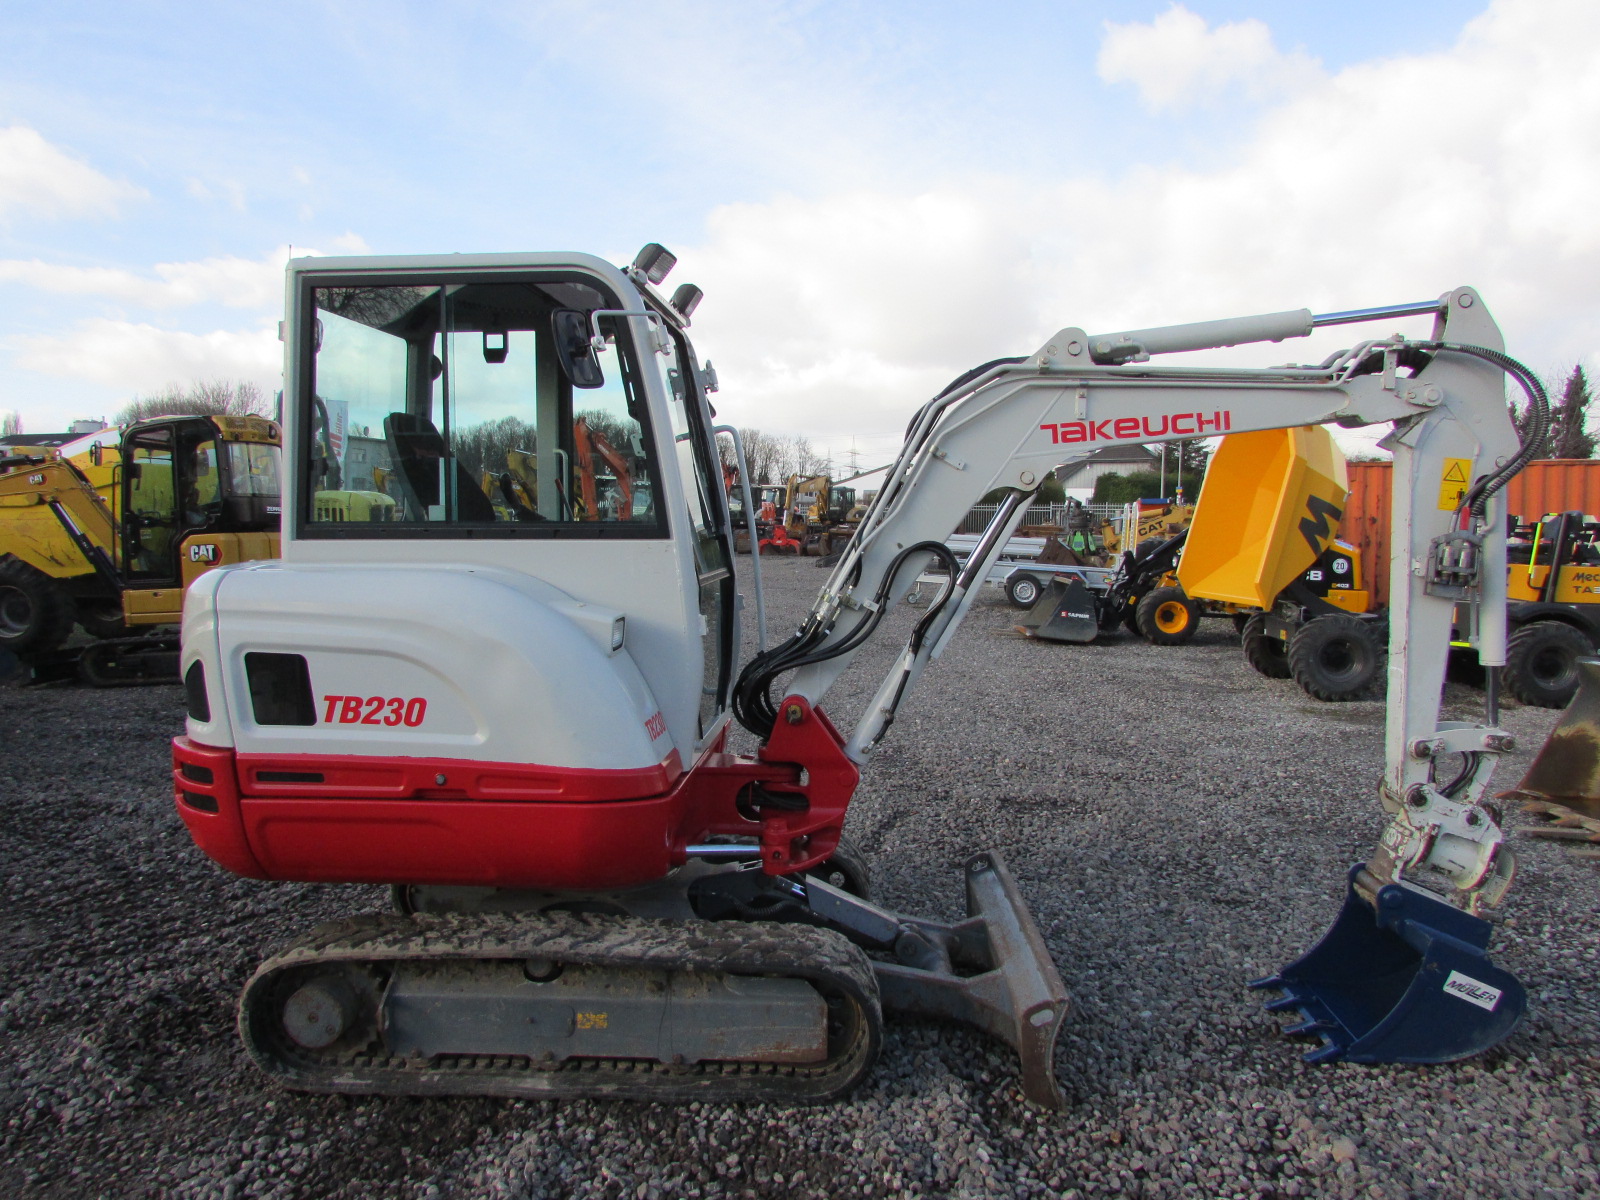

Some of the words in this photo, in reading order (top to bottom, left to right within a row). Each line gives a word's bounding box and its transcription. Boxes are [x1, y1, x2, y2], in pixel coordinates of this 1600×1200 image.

[29, 473, 43, 485] CAT
[1138, 520, 1164, 537] CAT
[190, 544, 215, 562] CAT
[1335, 562, 1345, 571] 20
[323, 695, 428, 727] TB230
[644, 710, 667, 742] TB230
